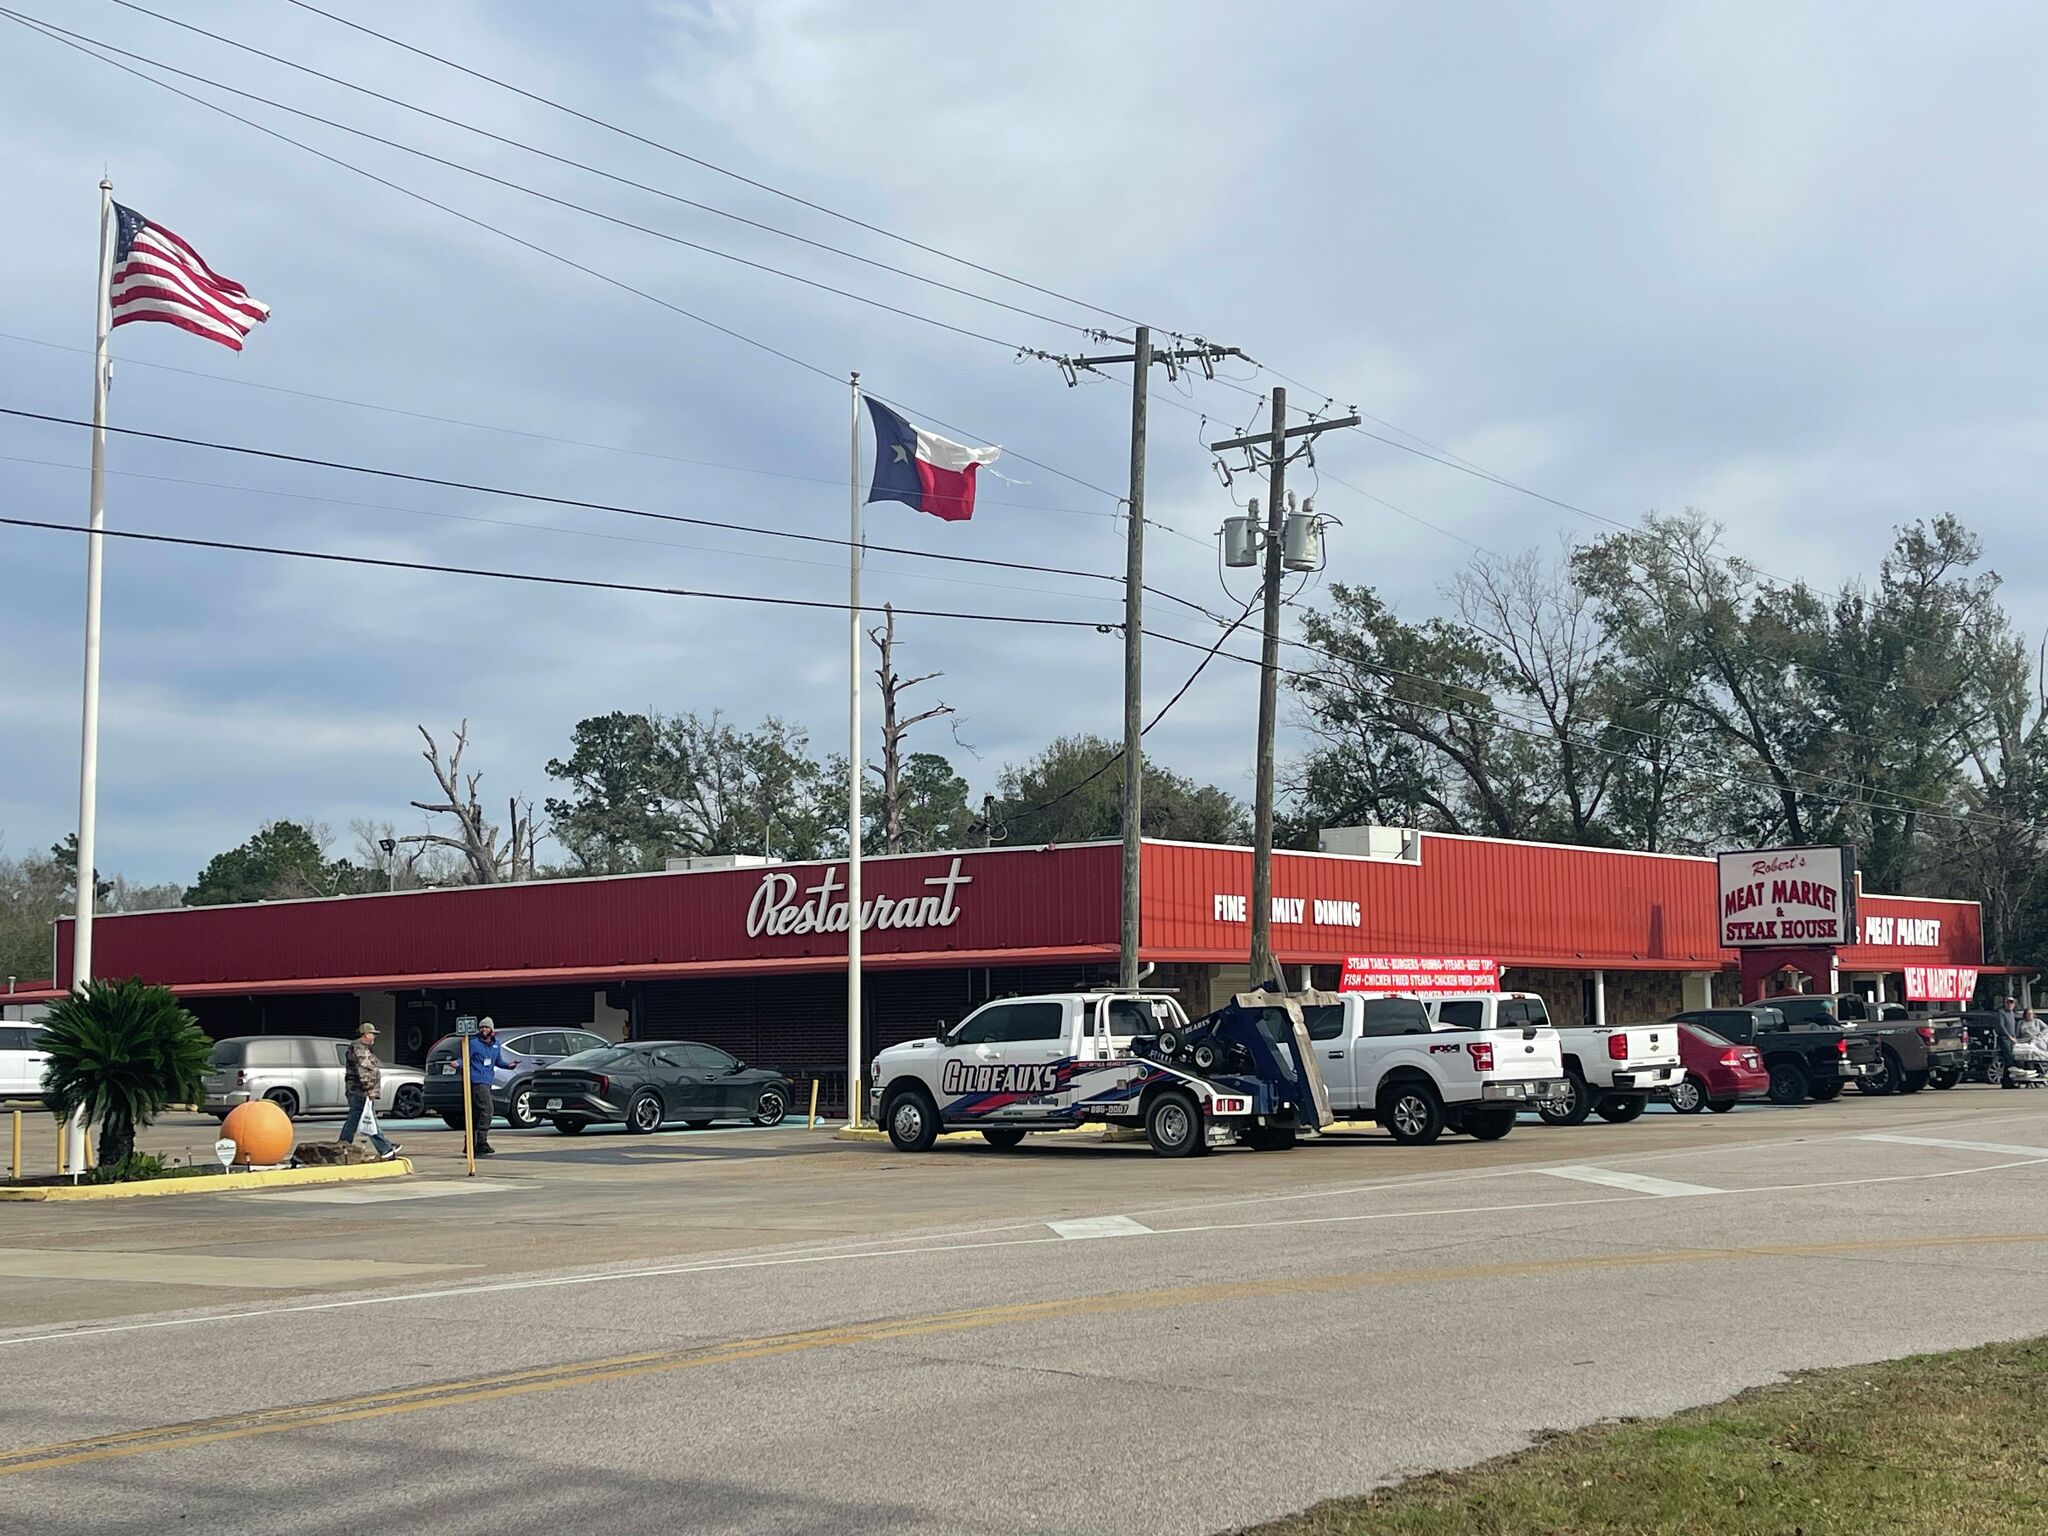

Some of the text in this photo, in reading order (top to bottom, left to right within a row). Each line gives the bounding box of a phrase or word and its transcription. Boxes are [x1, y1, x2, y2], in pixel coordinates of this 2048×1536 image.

[1752, 854, 1806, 876] Robert's
[746, 857, 973, 938] Restaurant
[1214, 894, 1361, 928] FINE MILY DINING
[1725, 880, 1837, 918] MEAT MARKET
[1776, 906, 1785, 917] &
[1726, 921, 1777, 940] STEAK
[1781, 919, 1837, 939] HOUSE
[1865, 916, 1895, 945] MEAT
[1896, 918, 1941, 947] MARKET
[1904, 967, 1978, 999] MEAT MARKET OPEN
[1430, 1044, 1460, 1054] FX4
[943, 1060, 1059, 1095] GILBEAUXS
